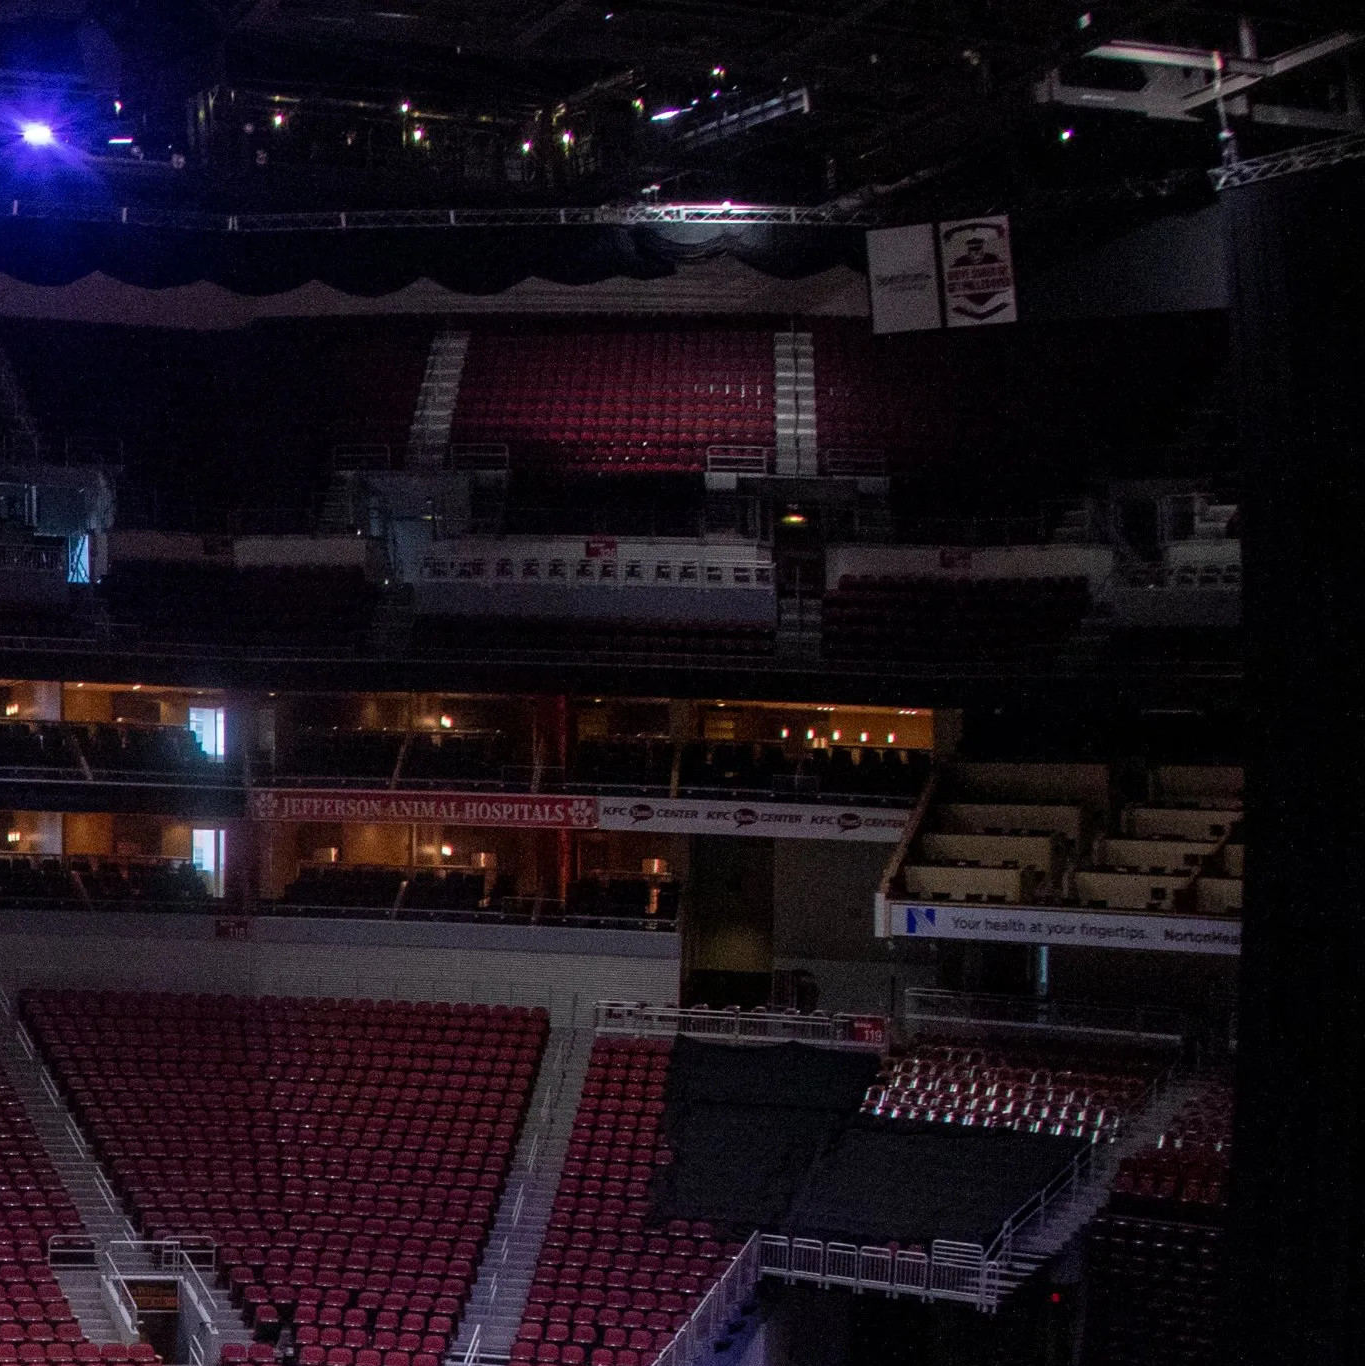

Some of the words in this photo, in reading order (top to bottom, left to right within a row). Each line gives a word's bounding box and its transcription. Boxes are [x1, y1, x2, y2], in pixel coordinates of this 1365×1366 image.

[281, 797, 383, 818] JEFFERSON
[387, 799, 461, 818] ANIMAL
[465, 801, 565, 821] HOSPITALS
[603, 807, 626, 817] KFC
[656, 808, 699, 819] CENTER
[706, 811, 731, 821] KFC
[760, 813, 802, 824] CENTER
[810, 815, 834, 825] KFC
[864, 818, 906, 828] CENTER
[952, 915, 983, 930] Your
[984, 917, 1027, 933] health
[1030, 921, 1043, 934] at
[1046, 922, 1077, 938] your
[1080, 920, 1149, 942] fingertips.
[864, 1029, 883, 1042] 119
